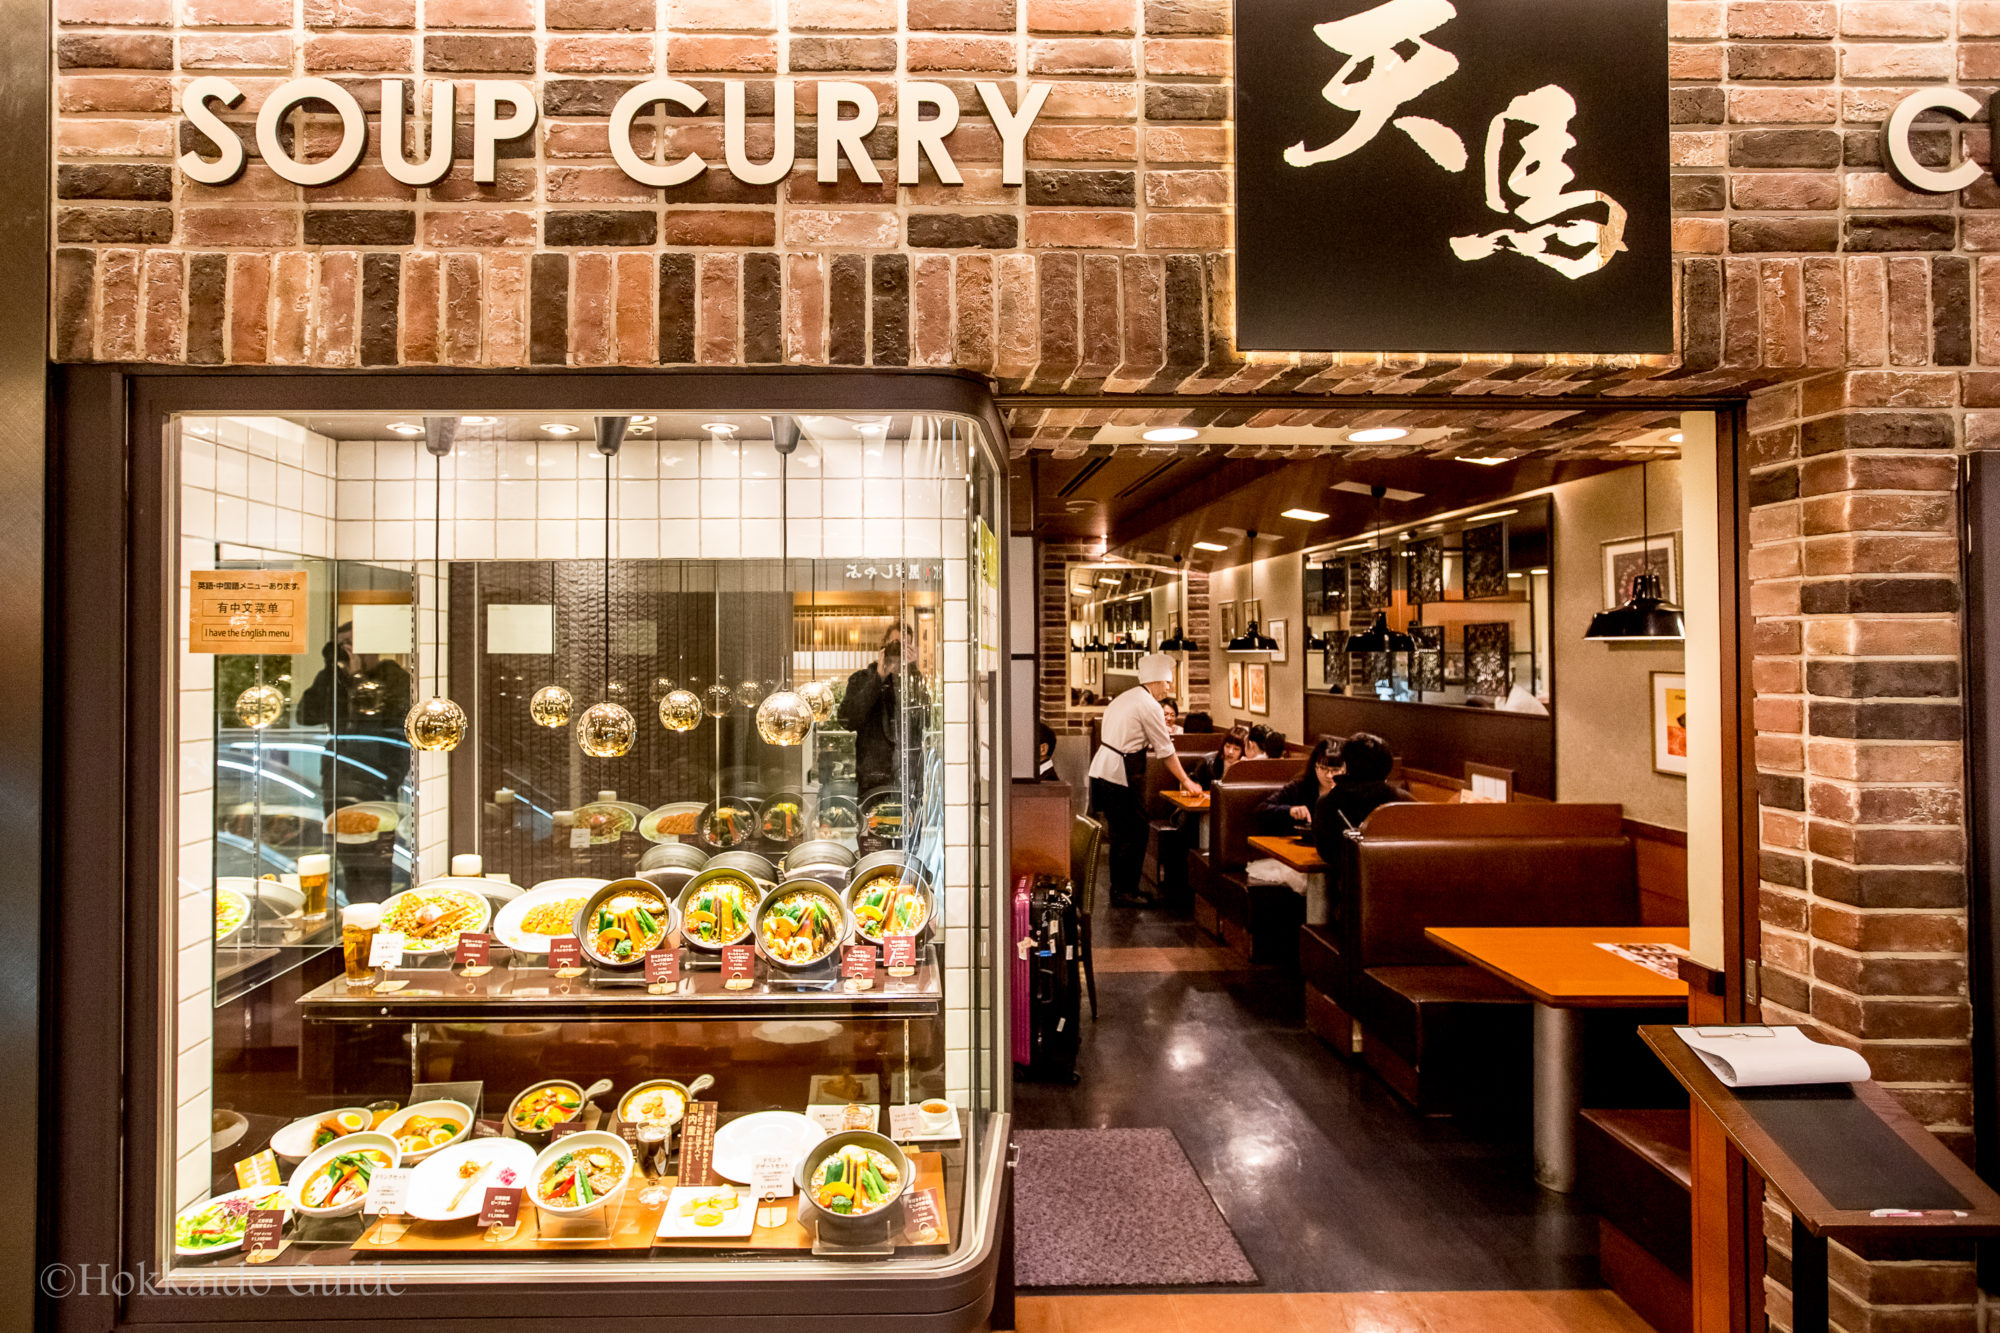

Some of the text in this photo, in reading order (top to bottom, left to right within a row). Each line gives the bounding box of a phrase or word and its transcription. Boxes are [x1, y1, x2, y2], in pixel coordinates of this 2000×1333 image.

[179, 75, 1052, 187] SOUP CURRY
[1284, 0, 1628, 280] 天馬
[1888, 87, 2000, 192] C
[205, 628, 208, 637] I
[209, 628, 226, 637] have
[227, 628, 240, 637] the
[241, 628, 267, 640] English
[217, 602, 279, 614] 有中文菜单
